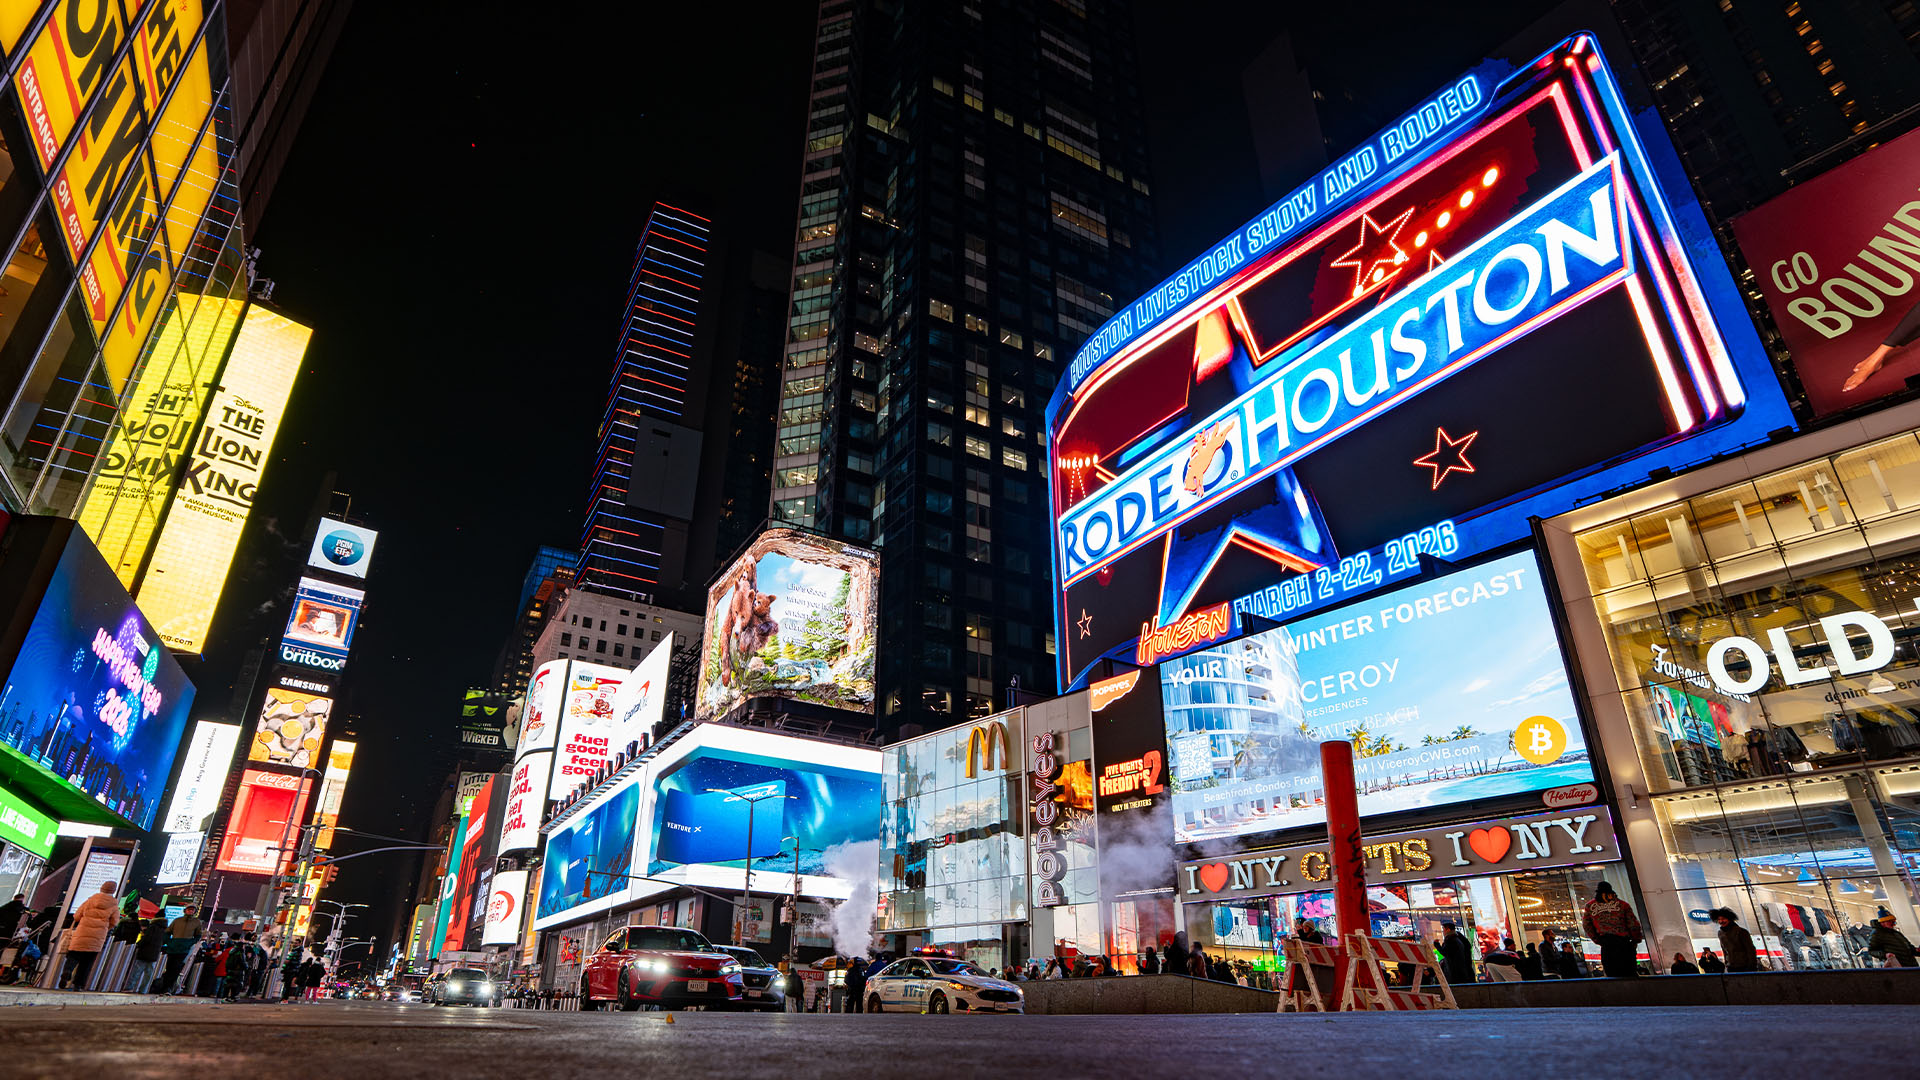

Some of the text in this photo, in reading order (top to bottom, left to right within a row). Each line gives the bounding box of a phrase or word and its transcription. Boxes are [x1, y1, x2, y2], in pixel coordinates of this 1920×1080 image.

[22, 66, 101, 305] ENTRANCE ON 45TH STREET
[1070, 75, 1481, 390] HOUSTON LIVESTOCK SHOW AND RODEO
[1771, 251, 1819, 294] GO
[1062, 186, 1622, 577] RODEO HOUSTON
[222, 406, 265, 435] THE
[198, 425, 262, 466] LION
[179, 457, 257, 503] KING
[184, 503, 234, 522] BEST MUSICAL
[1233, 572, 1313, 628] MARCH
[1385, 518, 1458, 576] 2026
[1169, 568, 1526, 690] YOUR NEW WINTER FORECAST
[282, 647, 341, 671] britbox
[1650, 643, 1711, 689] Famous
[1706, 610, 1896, 696] OLD
[92, 627, 128, 675] HAPPY
[121, 658, 144, 697] NEW
[141, 680, 162, 716] YEAR
[280, 676, 330, 694] SAMSUNG
[1306, 697, 1369, 719] RESIDENCES
[1824, 687, 1869, 703] denim
[1364, 704, 1422, 732] BEACH
[565, 743, 608, 757] good
[574, 734, 609, 747] fuel
[561, 765, 596, 777] goo
[570, 755, 606, 768] feel
[1099, 750, 1164, 797] FREDDY'S 2
[1105, 758, 1144, 779] FIVE NIGHTS
[1203, 784, 1253, 804] Beachfront
[1254, 779, 1292, 794] Condos
[1293, 775, 1320, 789] From
[1378, 744, 1482, 773] ViceroyCWB.com
[463, 774, 490, 787] LITTLE
[1111, 802, 1124, 813] ONLY
[1129, 798, 1152, 811] THEATERS
[1546, 787, 1594, 804] Heritage
[667, 821, 702, 833] VENTURE X
[161, 857, 194, 875] SQUARE
[1184, 865, 1201, 895] I
[1300, 837, 1433, 883] GTS
[1445, 831, 1471, 867] I
